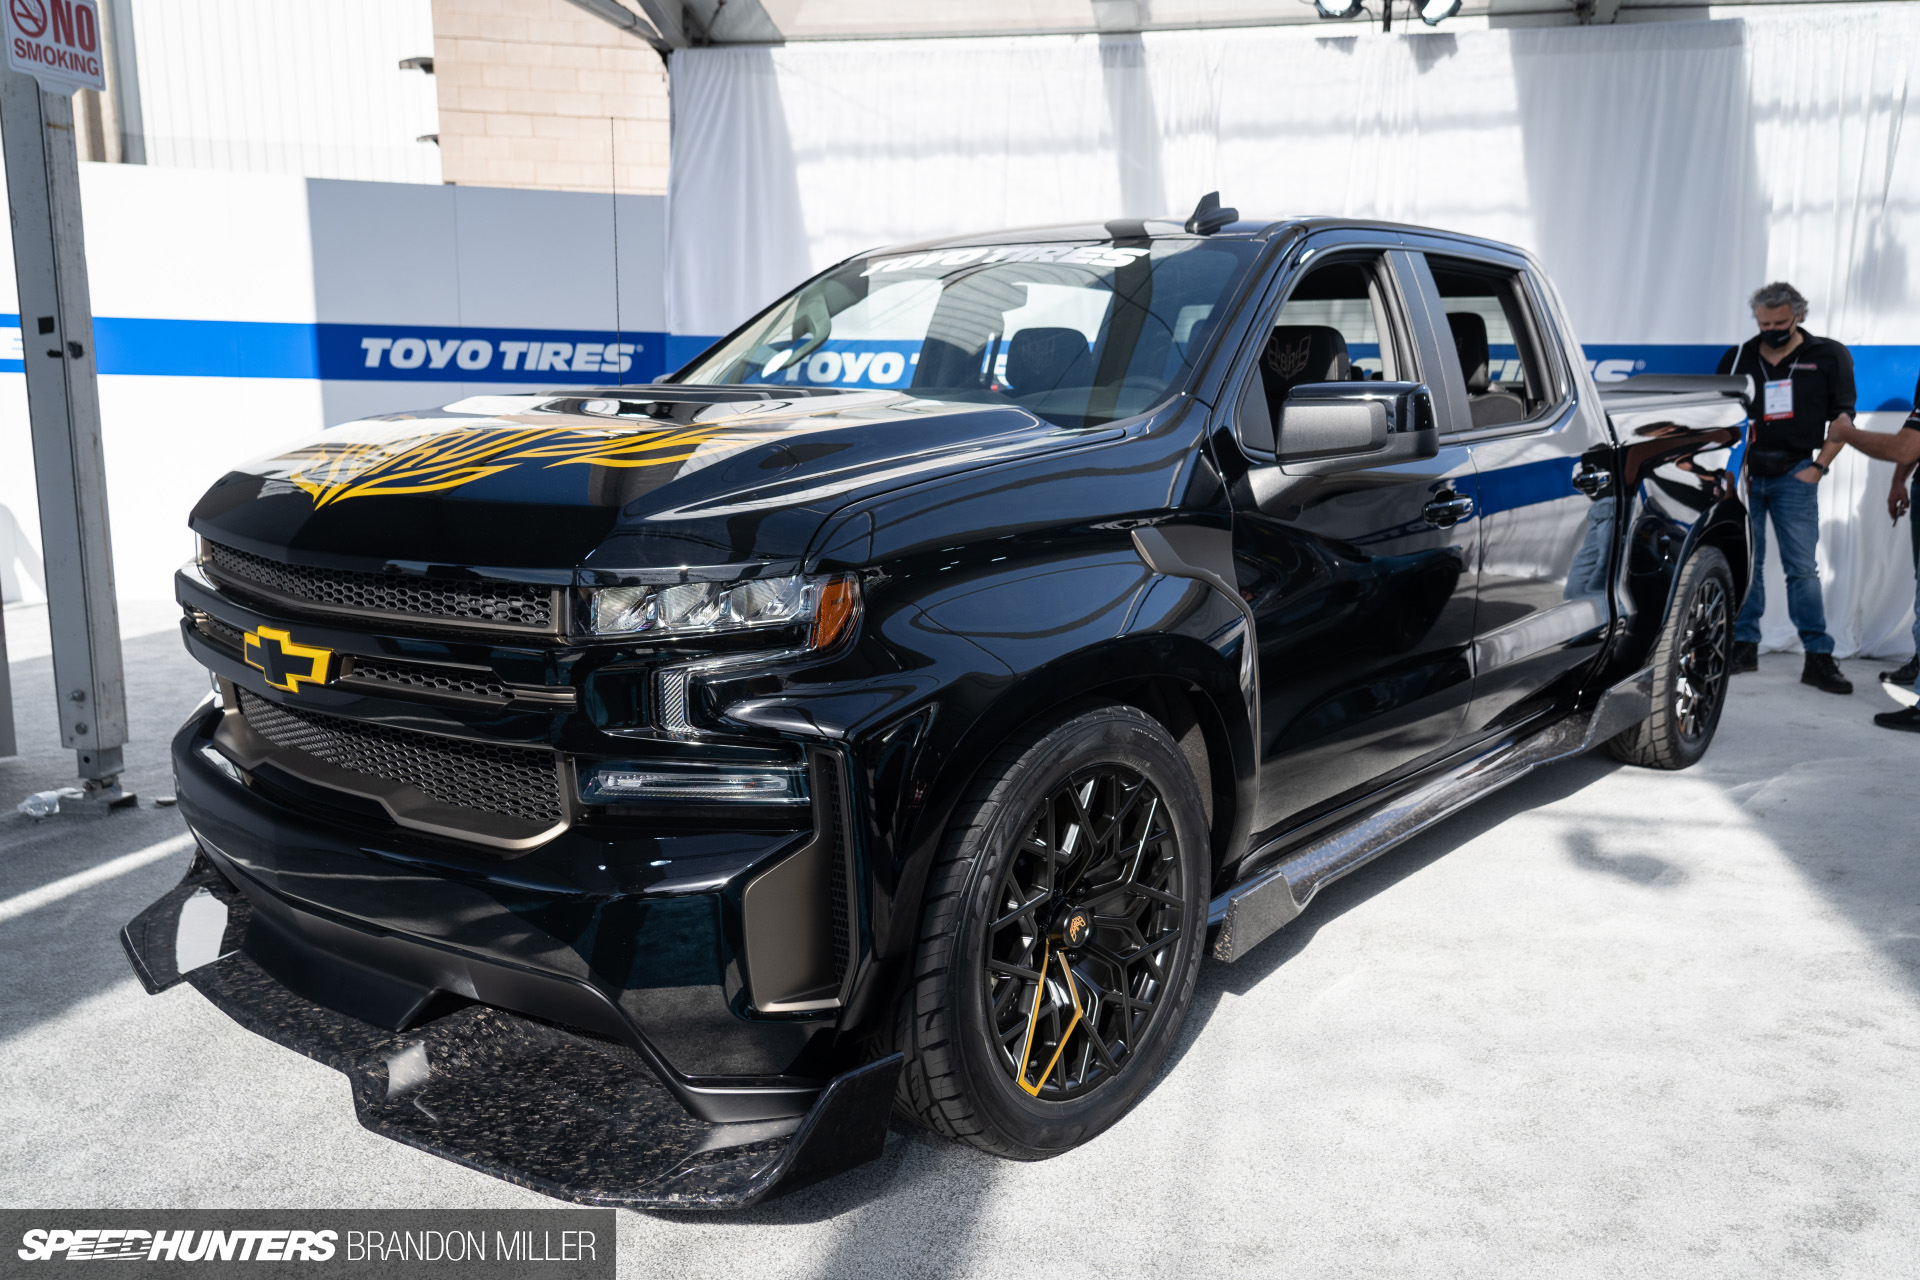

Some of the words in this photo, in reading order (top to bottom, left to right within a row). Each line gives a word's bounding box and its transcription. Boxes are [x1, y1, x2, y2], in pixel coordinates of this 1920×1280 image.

[50, 0, 96, 53] NO
[14, 38, 100, 77] SMOKING
[860, 248, 990, 277] TOYO
[983, 246, 1150, 267] TIRES
[361, 337, 493, 370] TOYO
[499, 341, 636, 373] TIRES
